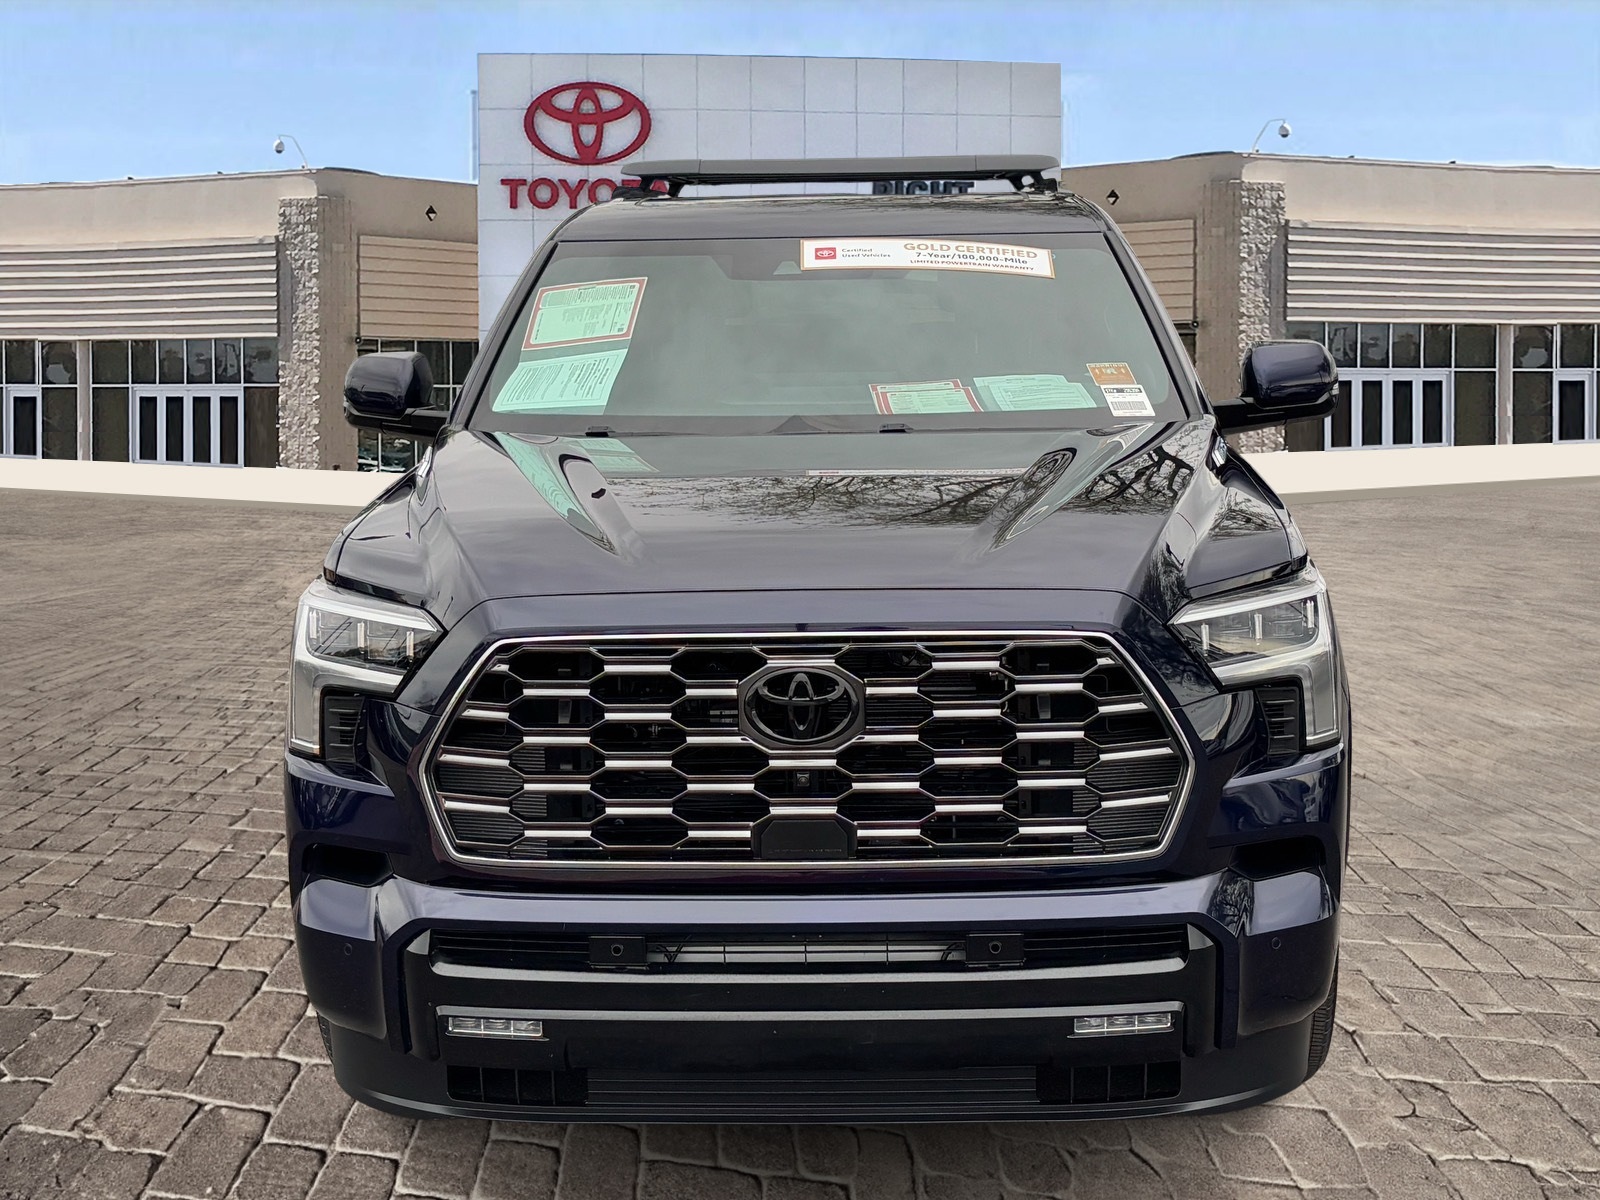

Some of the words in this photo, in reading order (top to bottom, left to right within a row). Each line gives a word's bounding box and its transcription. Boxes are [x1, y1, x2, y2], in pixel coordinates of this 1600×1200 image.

[903, 243, 951, 252] GOLD
[954, 244, 1038, 259] CERTIFIED
[940, 260, 991, 268] POWERTRAIN
[992, 263, 1035, 271] WARRANTY
